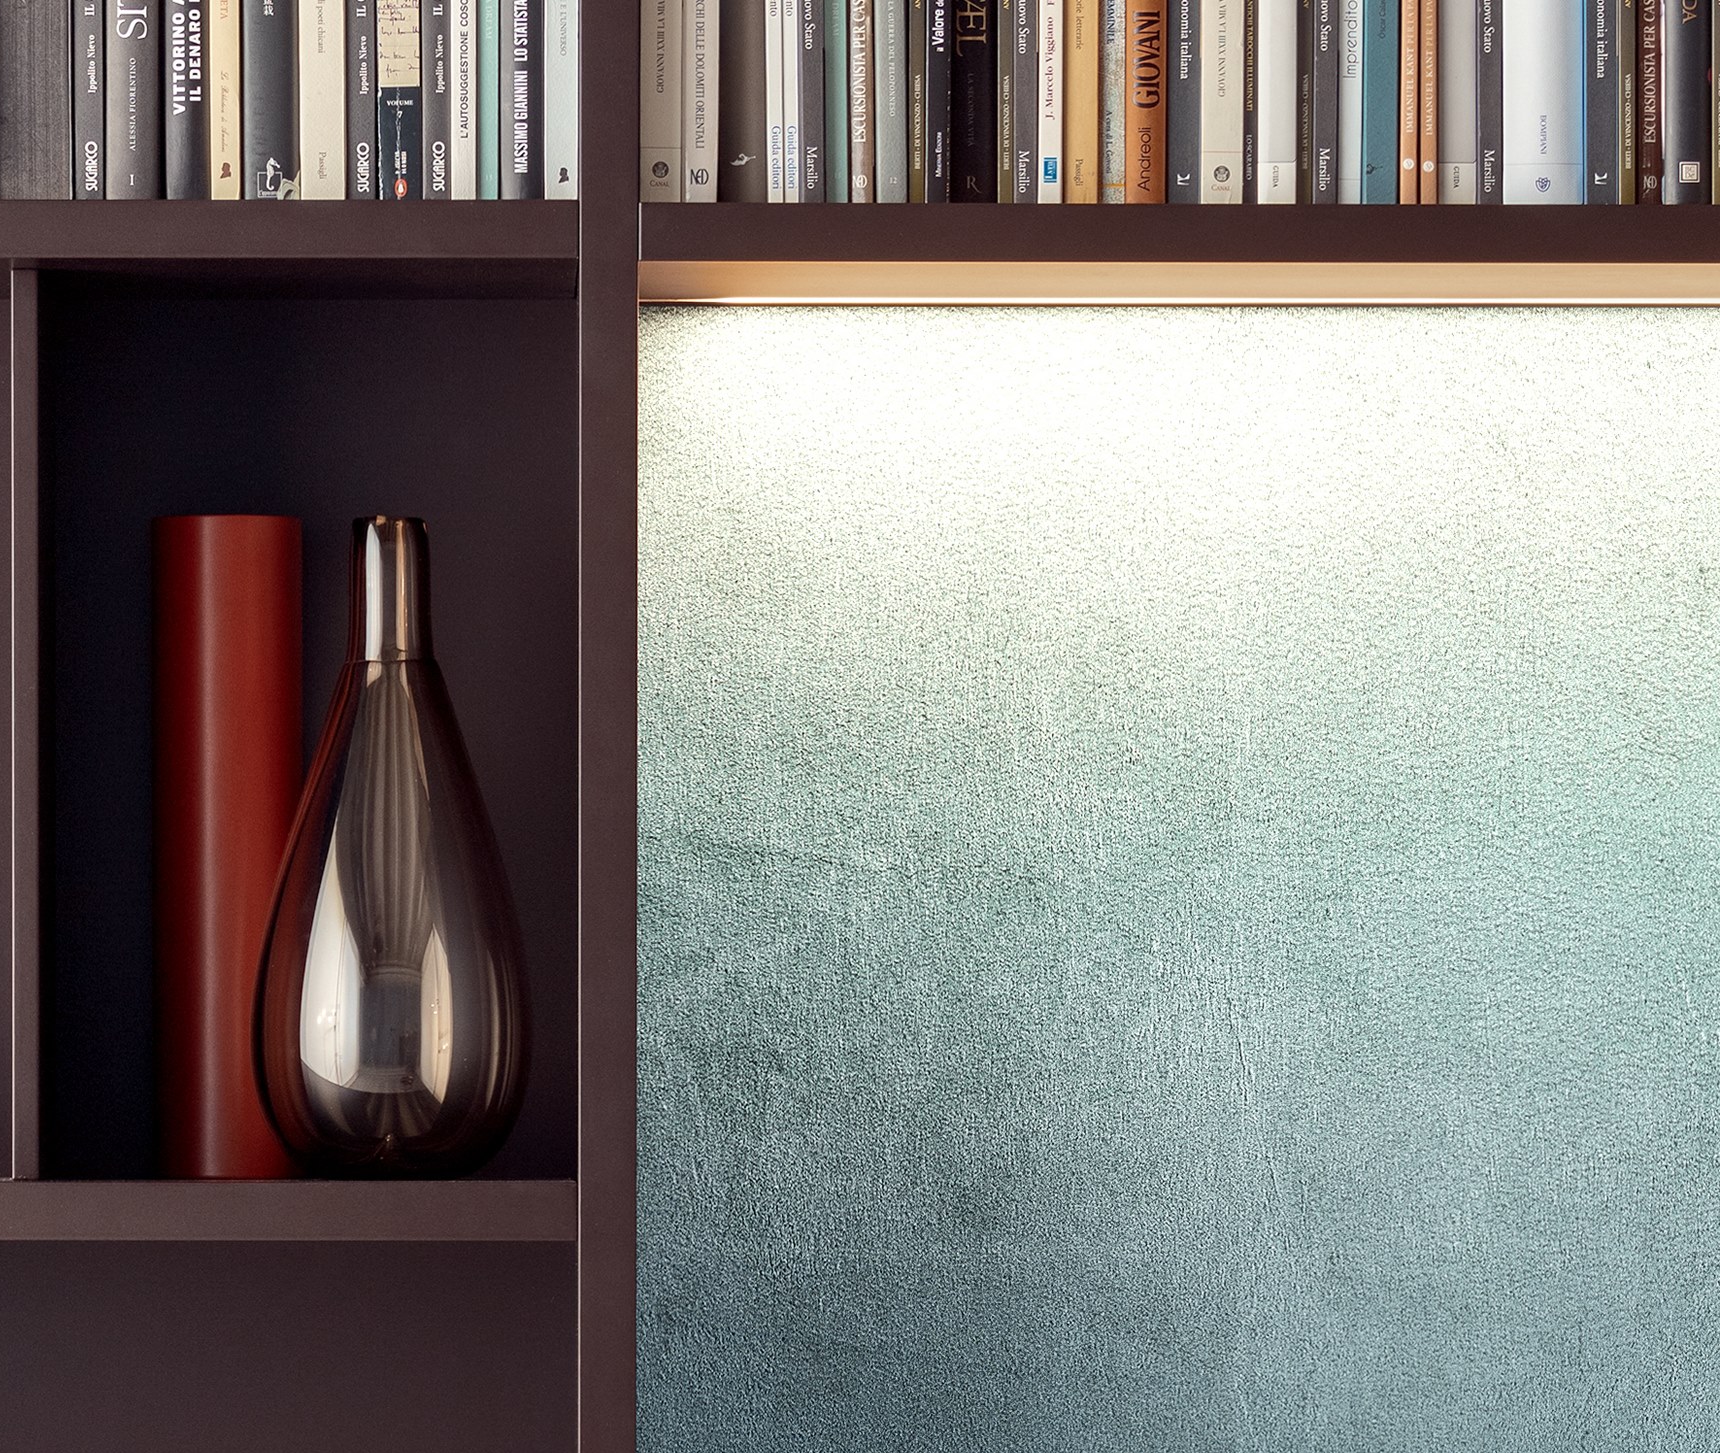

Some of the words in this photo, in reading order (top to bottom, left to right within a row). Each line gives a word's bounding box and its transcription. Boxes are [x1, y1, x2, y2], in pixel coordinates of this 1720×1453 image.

[87, 34, 96, 58] Nievo
[189, 9, 201, 80] DENARO
[359, 36, 368, 60] Nievo
[436, 34, 444, 58] Nievo
[696, 21, 705, 50] DELLE
[804, 22, 816, 50] Stato
[852, 24, 866, 49] PER
[932, 9, 945, 46] Valore
[1018, 27, 1030, 54] Stato
[1045, 16, 1056, 63] Viggiano
[1320, 24, 1332, 51] Stato
[1483, 26, 1495, 53] Stato
[1643, 24, 1656, 49] PER
[172, 12, 186, 115] VITTORINO
[514, 47, 528, 62] LO
[656, 53, 665, 94] GIOVANNI
[695, 53, 705, 98] DOLOMITI
[1132, 11, 1160, 109] GIOVANI
[1180, 42, 1192, 80] italiana
[1596, 42, 1608, 79] italiana
[87, 62, 97, 93] Ippolito
[189, 85, 201, 102] IL
[359, 62, 369, 95] Ippolito
[436, 62, 445, 93] Ippolito
[460, 31, 468, 139] L'AUTOSUGGESTIONE
[514, 70, 528, 121] GIANNINI
[852, 52, 866, 143] ESCURSIONISTA
[1045, 65, 1054, 109] Marcelo
[1643, 52, 1656, 143] ESCURSIONISTA
[695, 100, 705, 149] ORIENTALI
[787, 125, 796, 156] Guida
[86, 141, 98, 191] SUGARCO
[357, 142, 370, 192] SUGARCO
[433, 141, 445, 191] SUGARCO
[514, 123, 529, 174] MASSIMO
[806, 146, 818, 190] Marsilio
[1137, 126, 1151, 192] Andreoli
[1319, 148, 1331, 191] Marsilio
[1018, 150, 1030, 193] Marsilio
[1483, 150, 1495, 193] Marsilio
